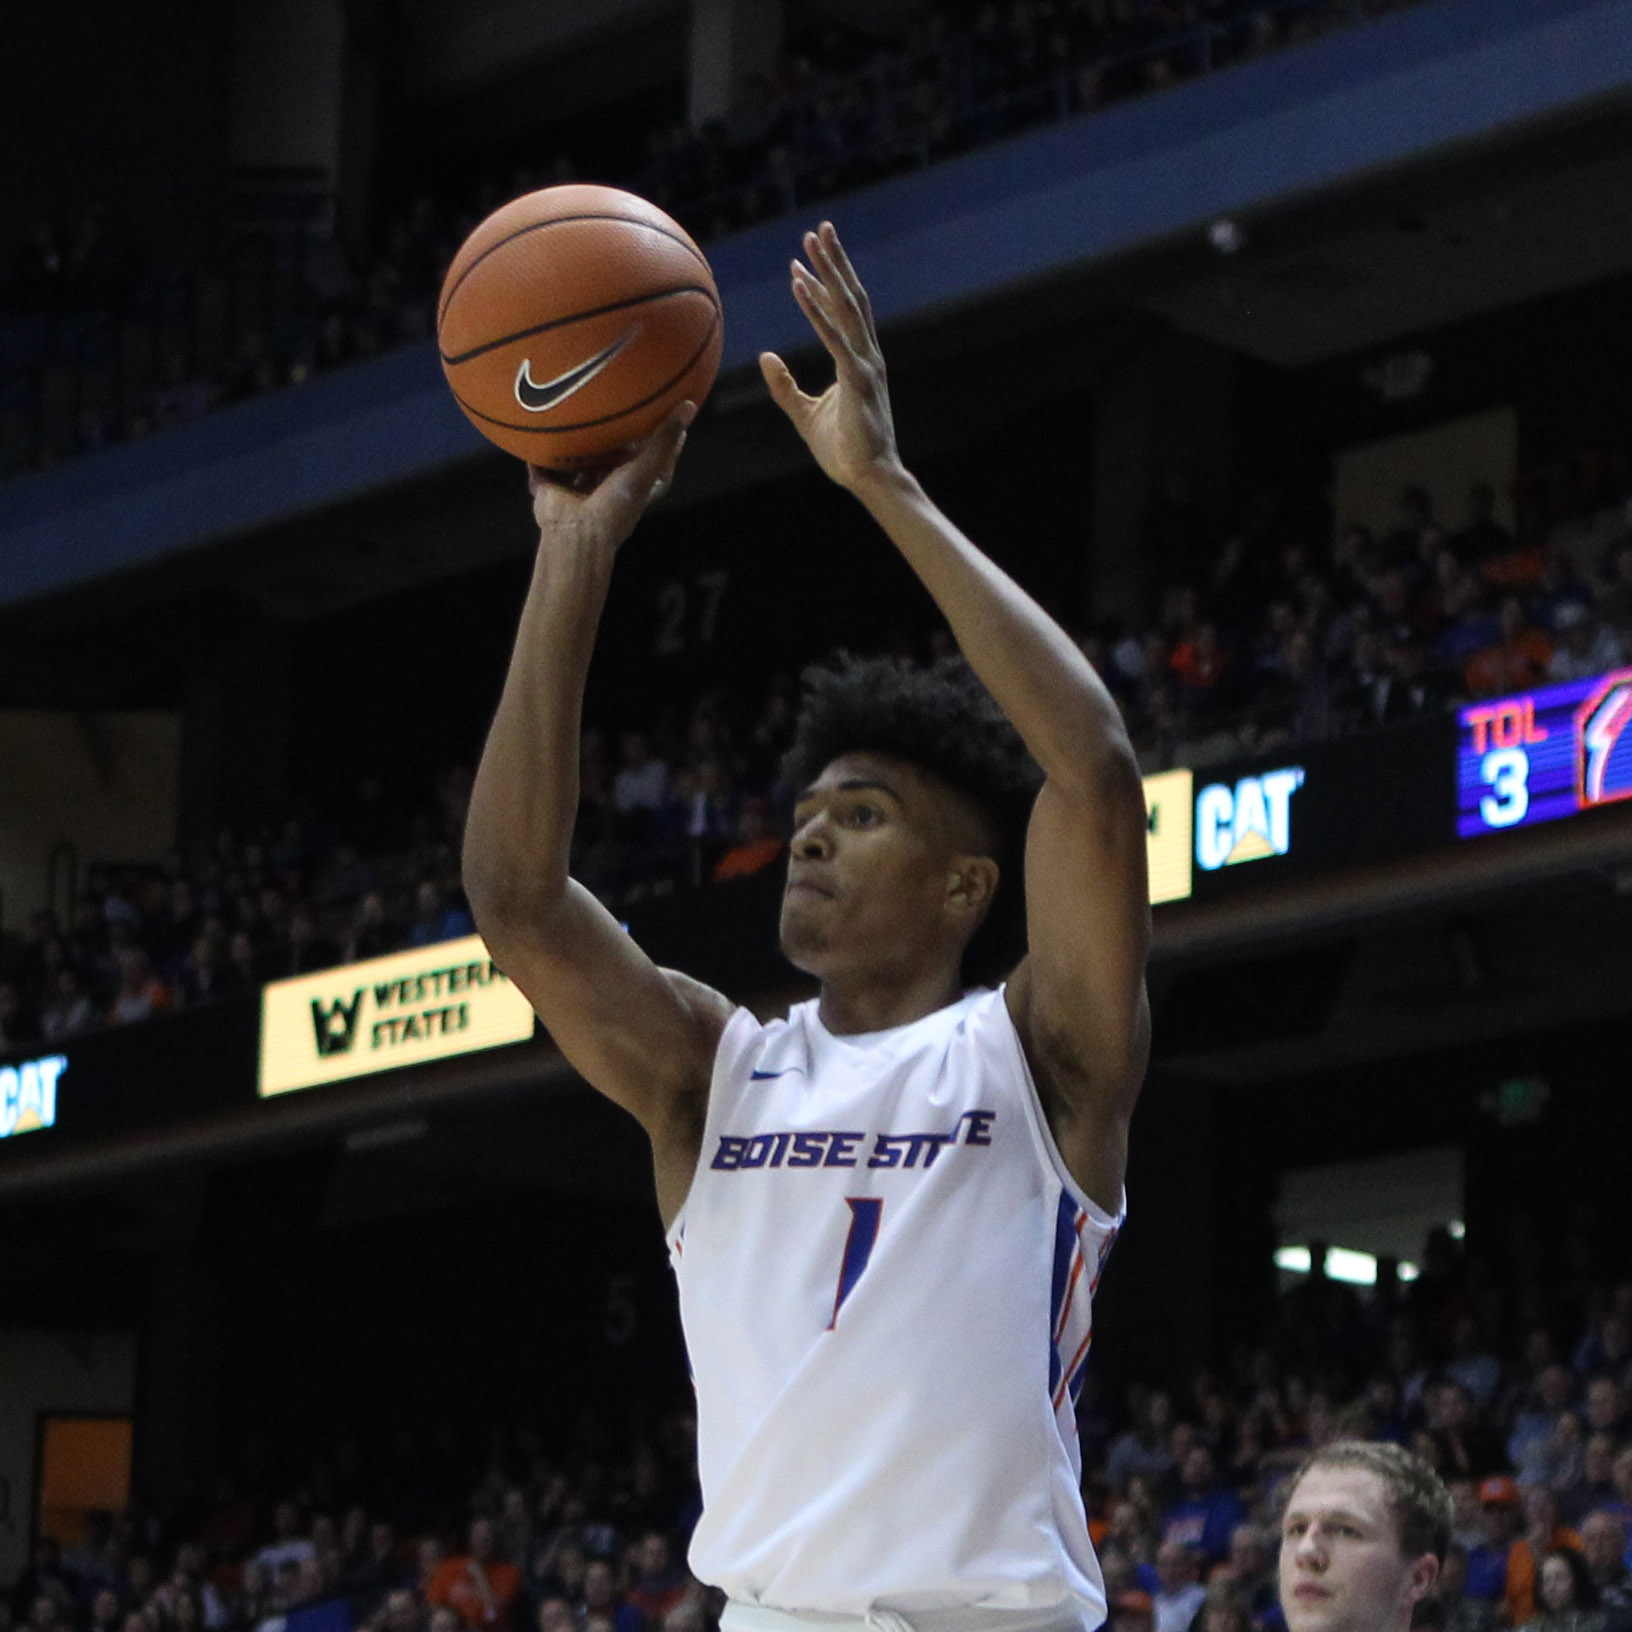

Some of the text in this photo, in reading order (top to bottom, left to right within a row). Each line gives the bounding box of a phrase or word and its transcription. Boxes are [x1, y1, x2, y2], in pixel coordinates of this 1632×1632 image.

[654, 570, 729, 656] 27
[1468, 697, 1549, 754] TOL
[1195, 771, 1298, 871] CAT
[1479, 746, 1531, 829] 3
[371, 1000, 469, 1050] STATES
[710, 1109, 997, 1171] BOISE STE
[825, 1196, 884, 1332] 1
